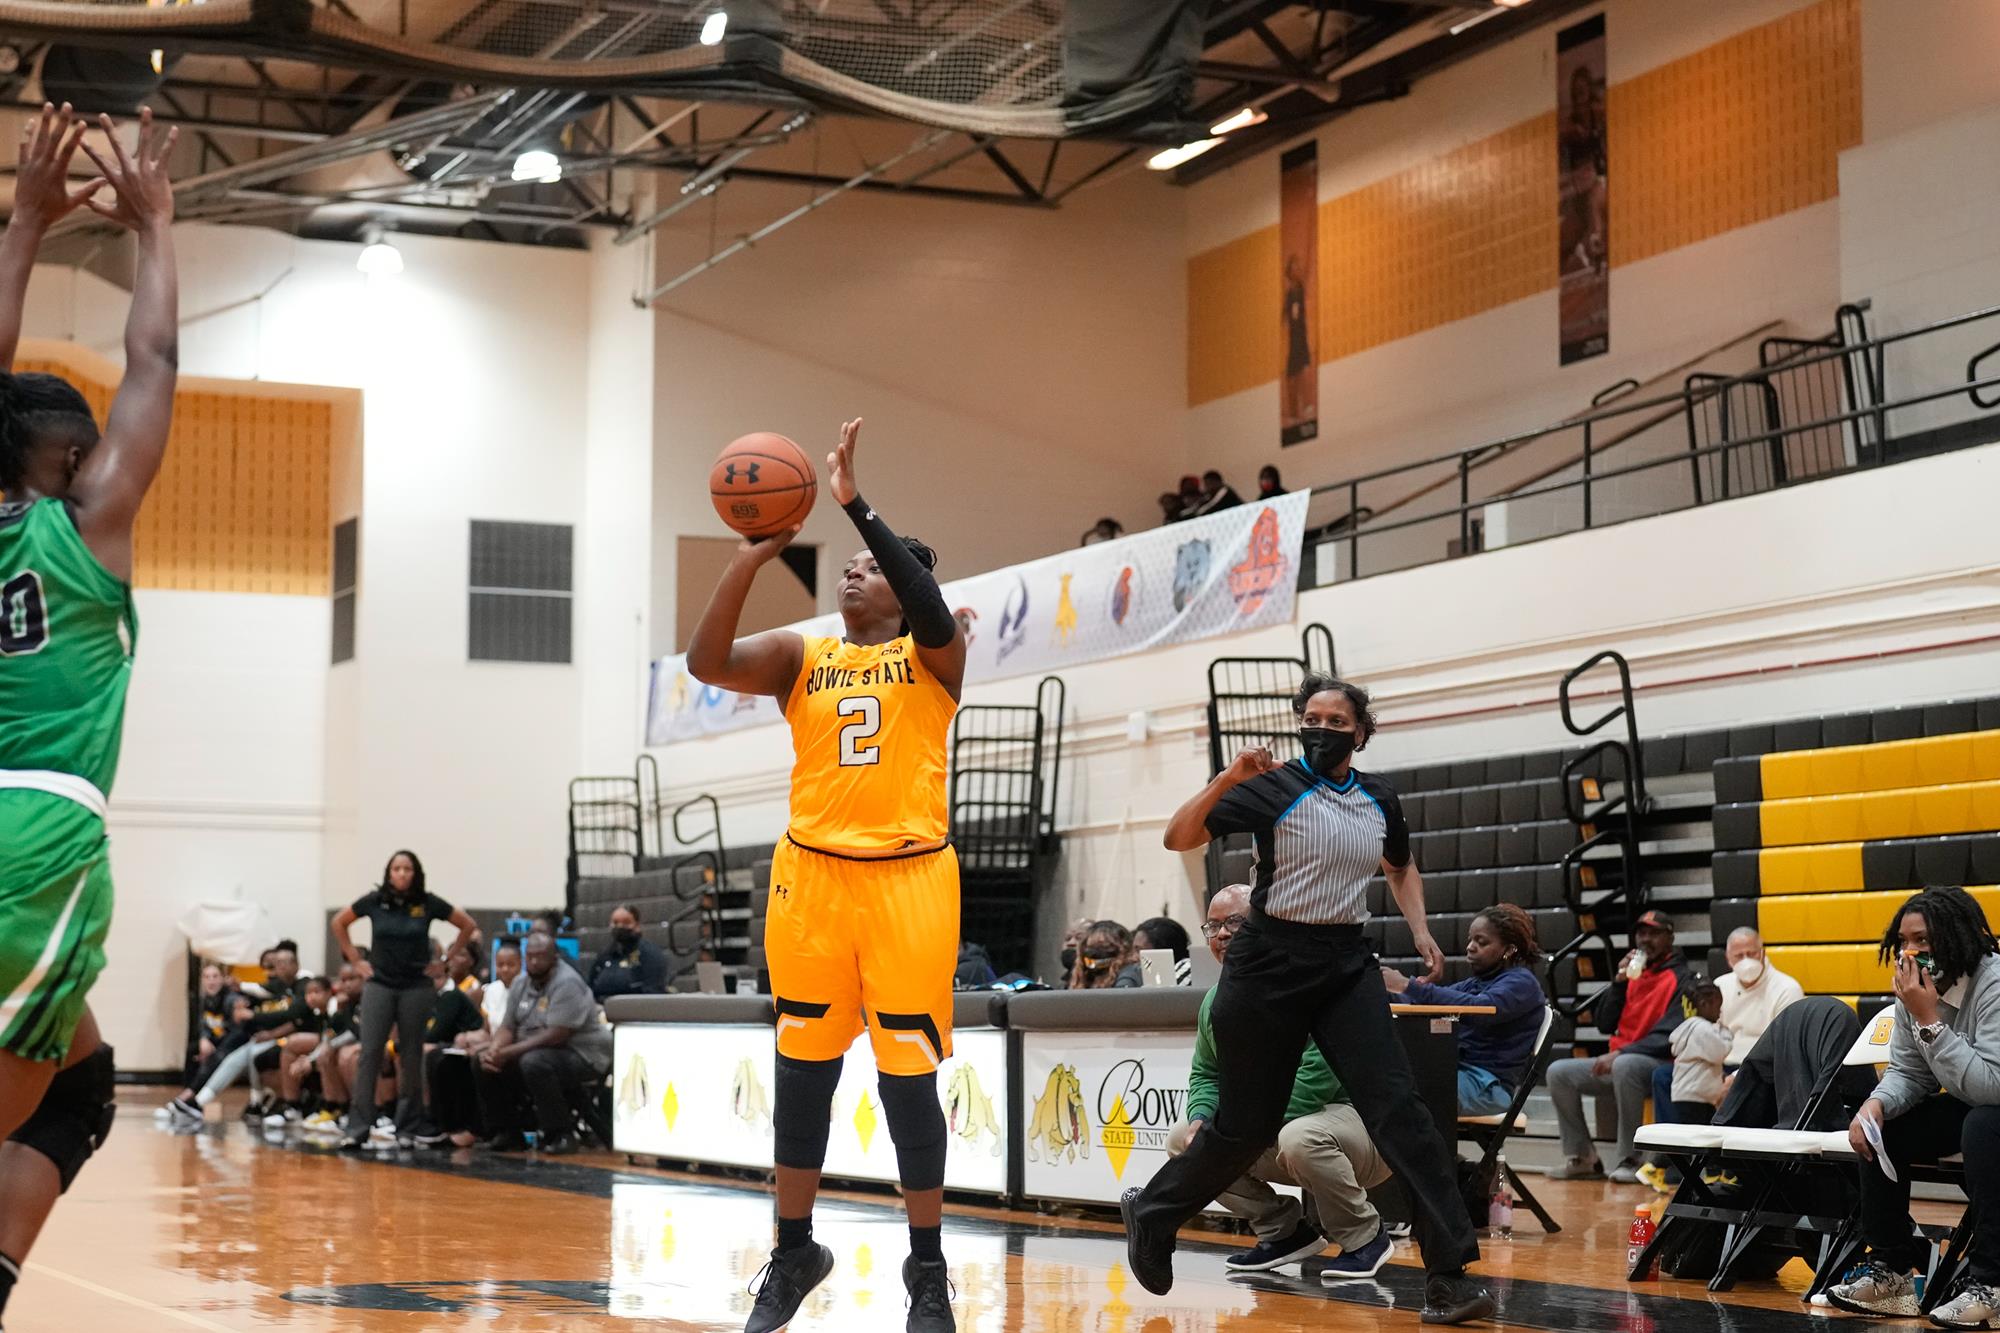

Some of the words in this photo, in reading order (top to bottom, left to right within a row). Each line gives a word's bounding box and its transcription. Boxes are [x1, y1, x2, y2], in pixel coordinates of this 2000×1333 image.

[807, 665, 857, 696] BOWIE
[862, 658, 915, 685] STATE
[837, 696, 881, 767] 2
[1869, 1016, 1896, 1045] B
[1103, 1130, 1135, 1145] STATE
[1137, 1131, 1169, 1146] UNIV
[1627, 1248, 1637, 1262] G
